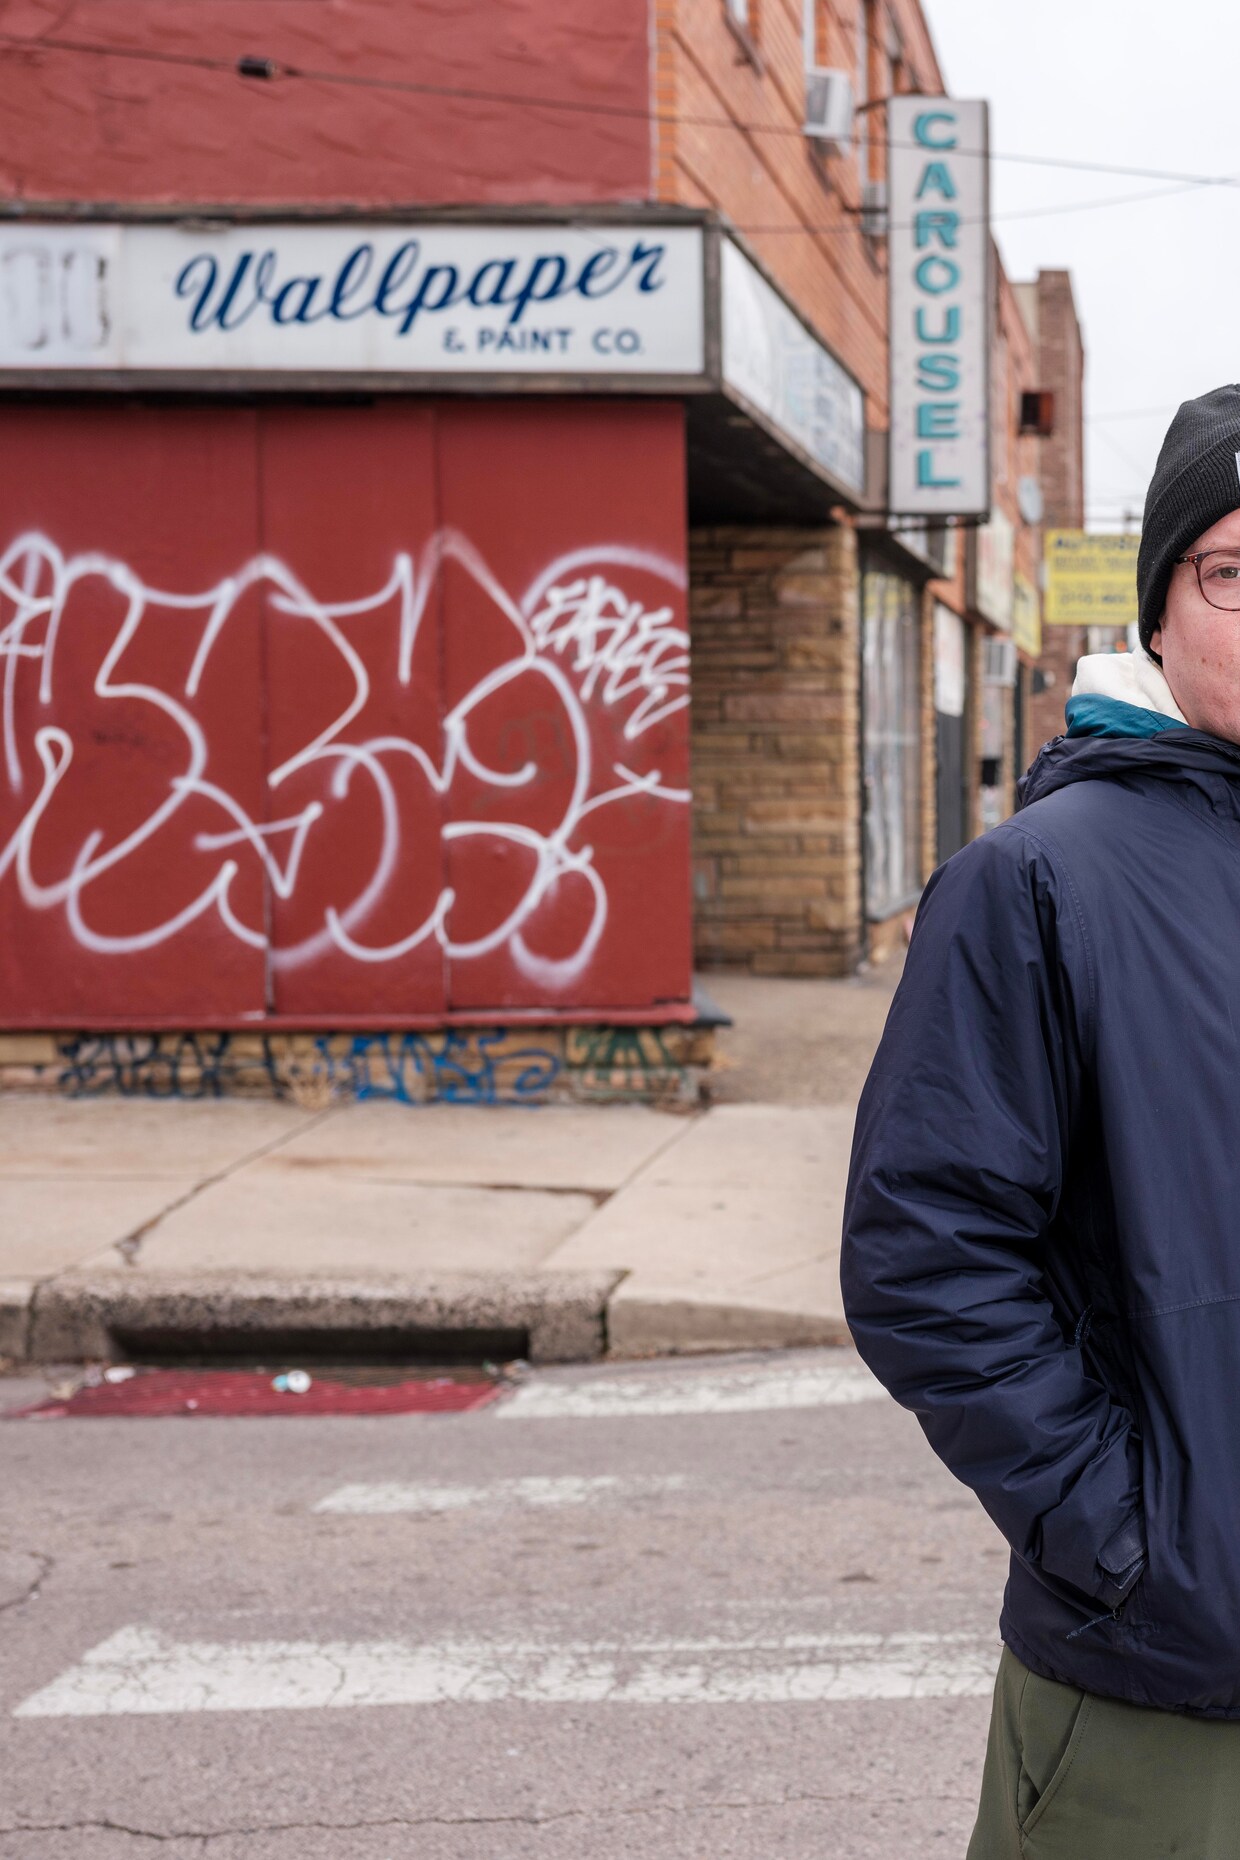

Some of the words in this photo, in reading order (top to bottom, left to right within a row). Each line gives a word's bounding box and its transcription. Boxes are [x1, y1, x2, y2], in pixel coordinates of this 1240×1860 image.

[175, 238, 666, 336] Wallpaper
[911, 110, 963, 490] CAROUSEL
[476, 326, 574, 355] PAINT
